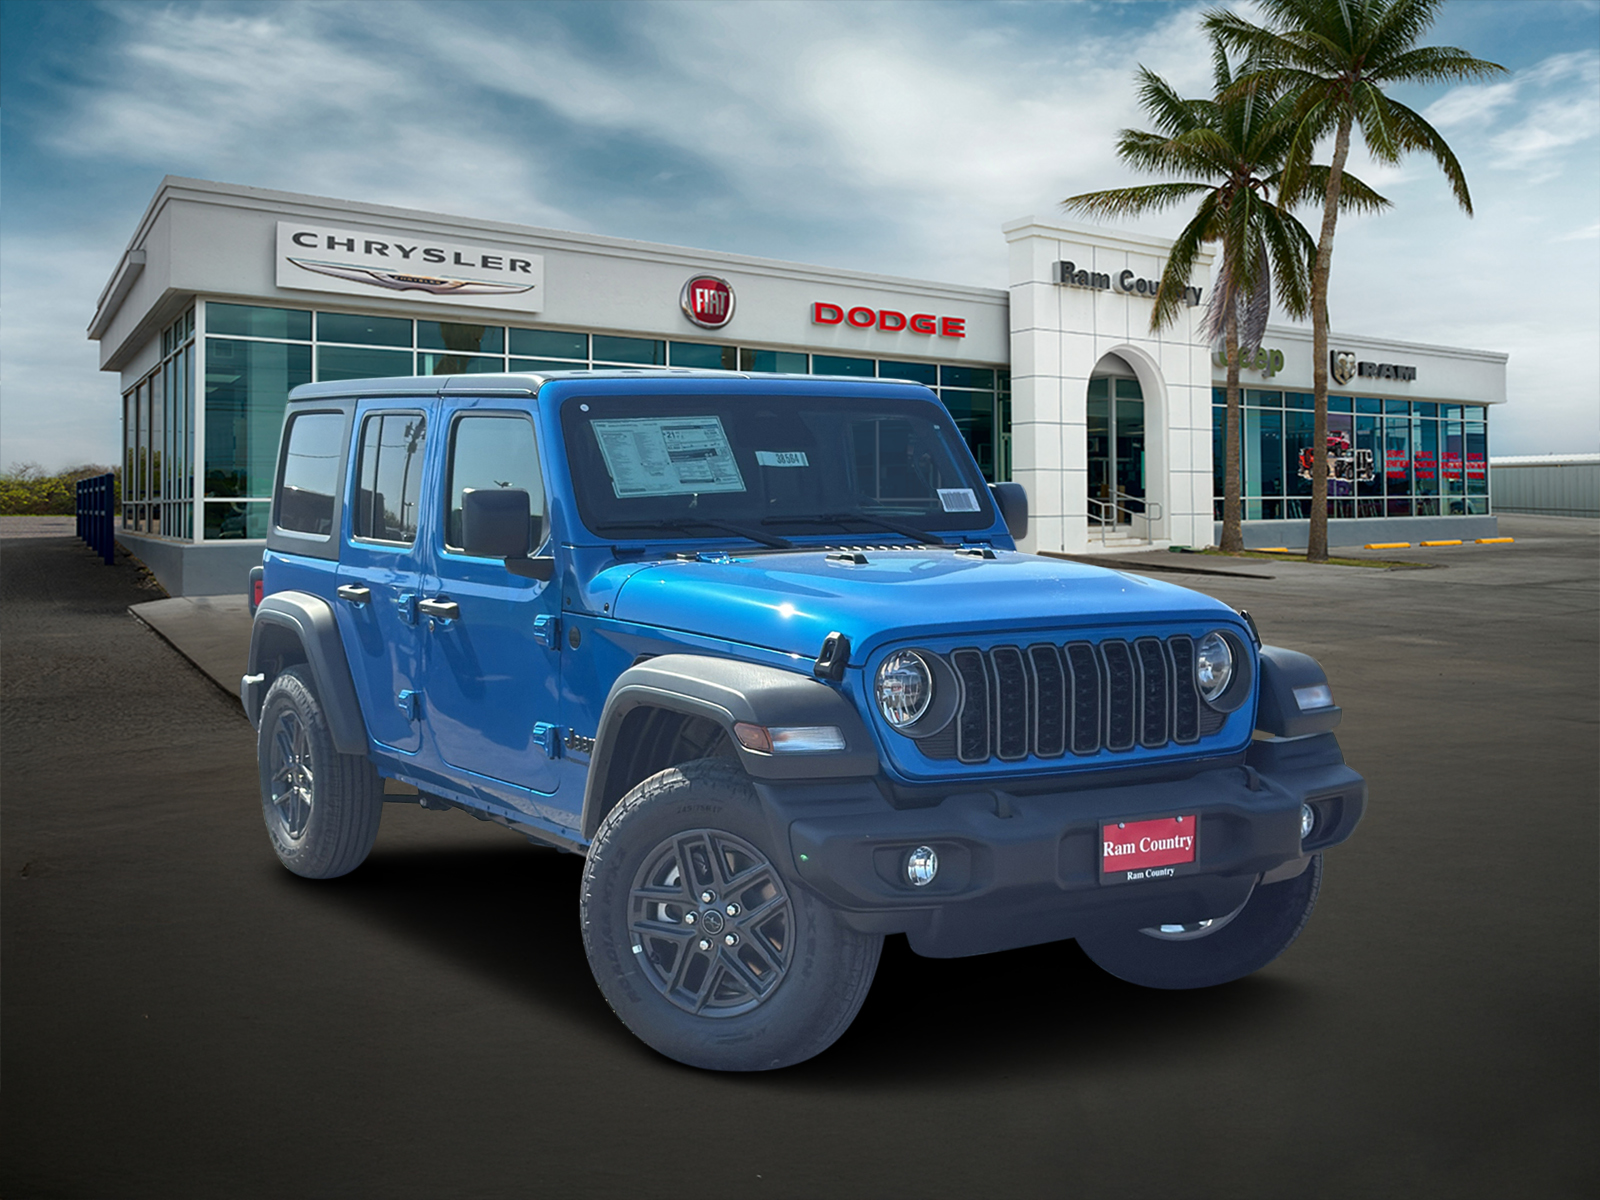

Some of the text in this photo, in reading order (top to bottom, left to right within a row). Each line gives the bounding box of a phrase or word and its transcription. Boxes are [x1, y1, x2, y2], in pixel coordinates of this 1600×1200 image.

[291, 231, 532, 274] CHRYSLER
[1054, 260, 1203, 306] Ram Coury
[695, 287, 727, 316] FIAT
[812, 301, 966, 338] DODGE
[1358, 361, 1417, 381] RAM
[1103, 834, 1194, 857] Ram Country
[1127, 867, 1175, 881] Ram Country
